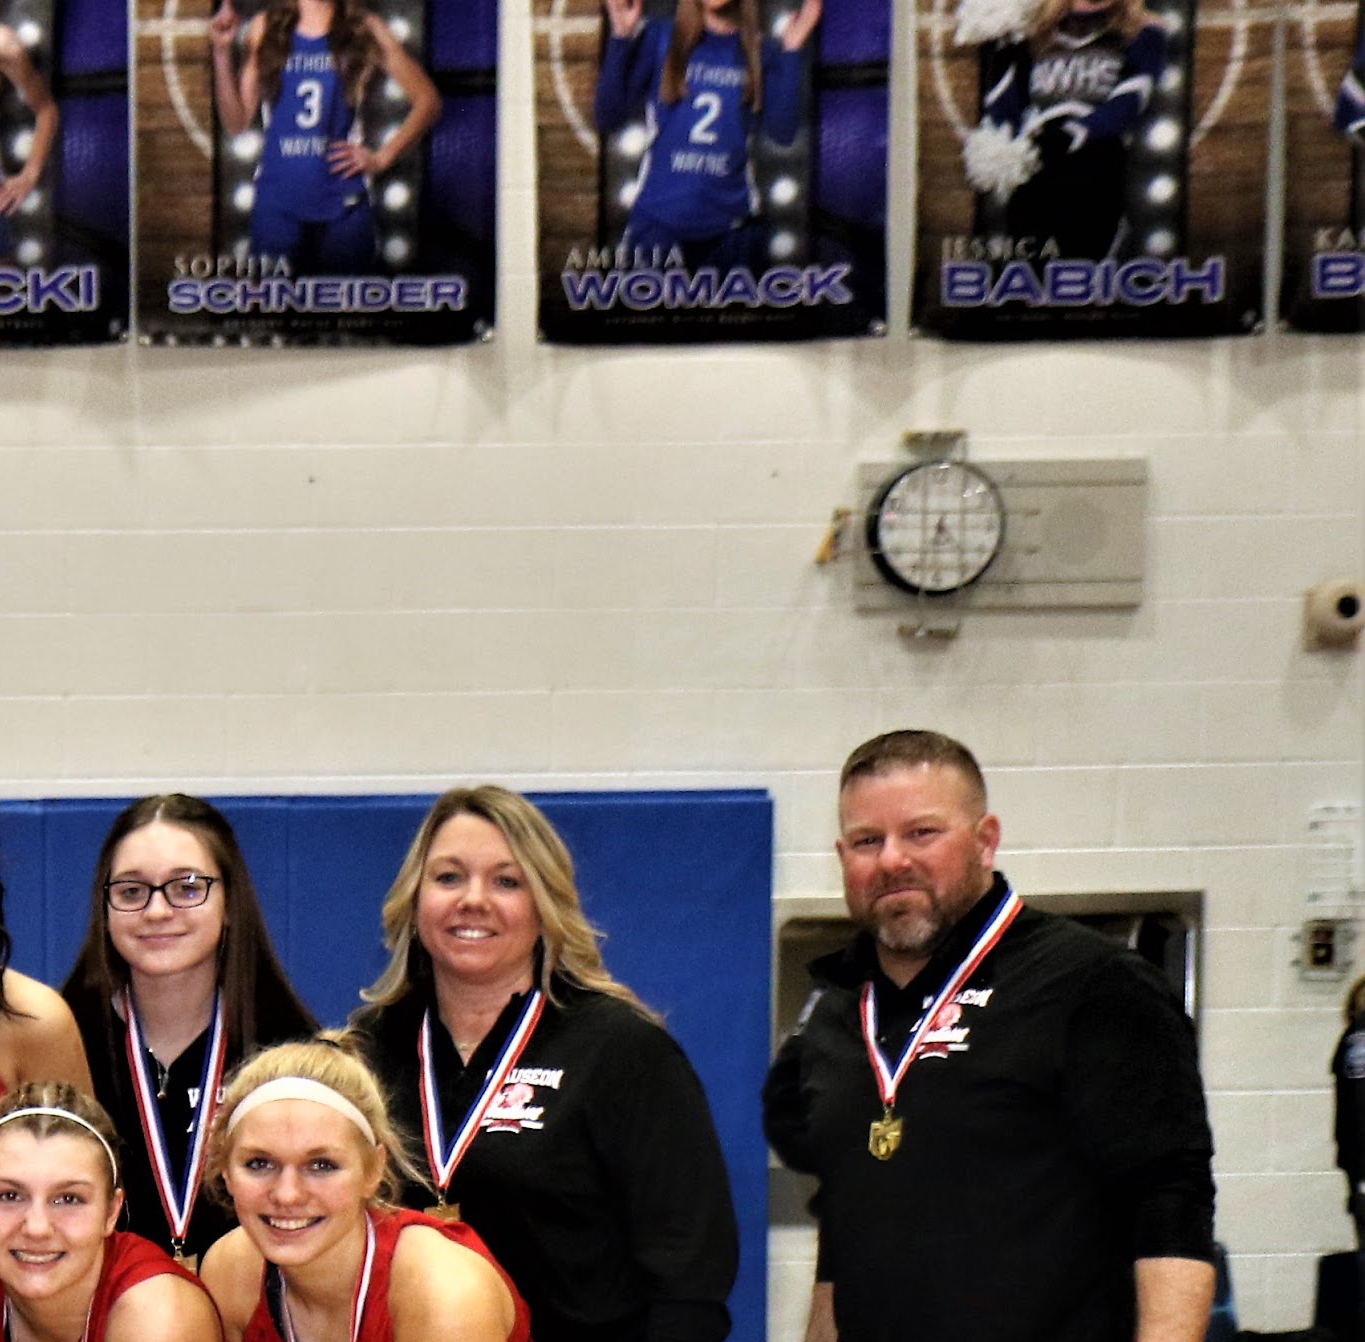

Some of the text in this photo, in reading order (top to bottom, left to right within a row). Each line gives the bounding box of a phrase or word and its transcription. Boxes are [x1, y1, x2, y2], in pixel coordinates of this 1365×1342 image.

[295, 78, 323, 130] 3
[688, 91, 722, 145] 2
[566, 245, 685, 270] AMELIA
[941, 235, 1062, 261] JESSICA
[1314, 228, 1365, 252] KA
[173, 254, 293, 278] SOPHIA
[941, 256, 1226, 308] BABICH
[168, 275, 468, 313] SCHNEIDER
[561, 263, 853, 311] WOMACK
